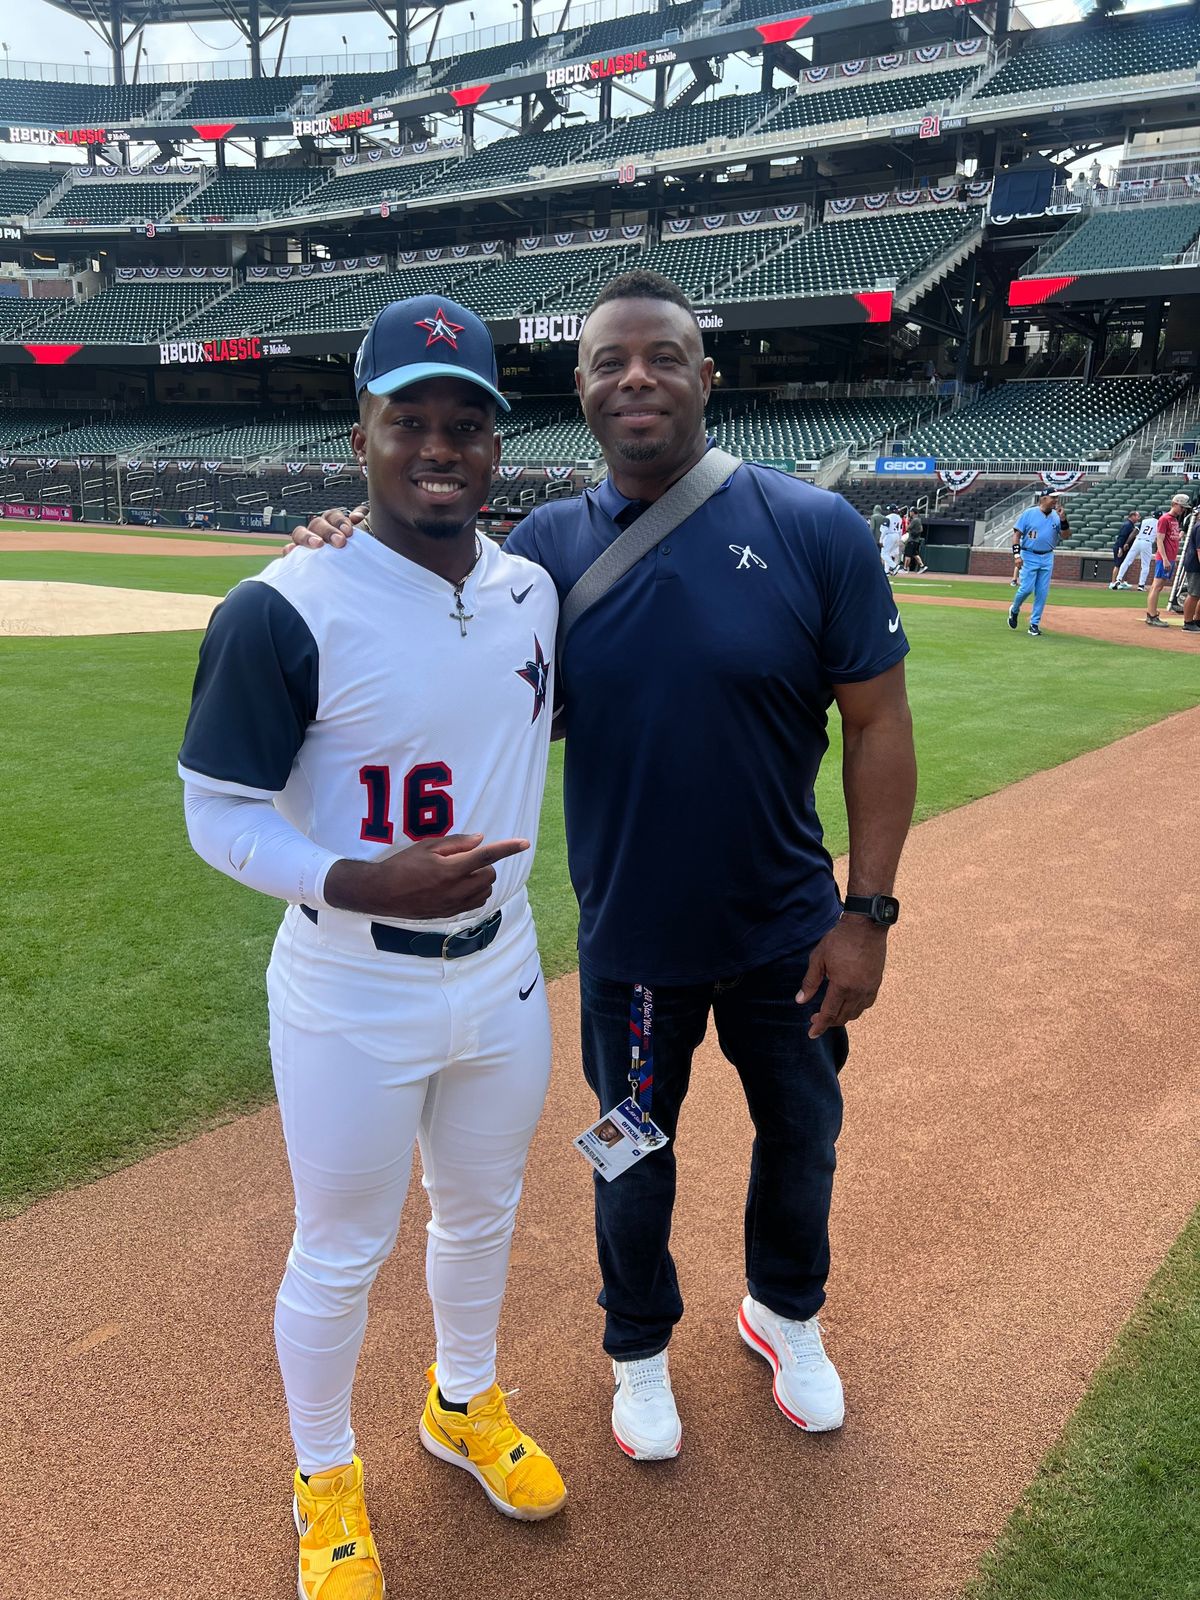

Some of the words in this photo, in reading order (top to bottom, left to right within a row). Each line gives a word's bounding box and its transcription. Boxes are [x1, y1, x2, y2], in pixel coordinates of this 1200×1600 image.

[895, 126, 920, 136] WARREN
[919, 114, 940, 138] 21
[619, 164, 635, 184] 10
[381, 201, 390, 218] 6
[4, 228, 21, 240] PM
[146, 223, 155, 238] 3
[883, 461, 927, 471] GEICO
[1142, 525, 1154, 536] 21
[359, 761, 454, 844] 16
[621, 1121, 640, 1141] OFFICIAL
[509, 1442, 527, 1464] NIKE
[331, 1541, 357, 1562] NIKE
